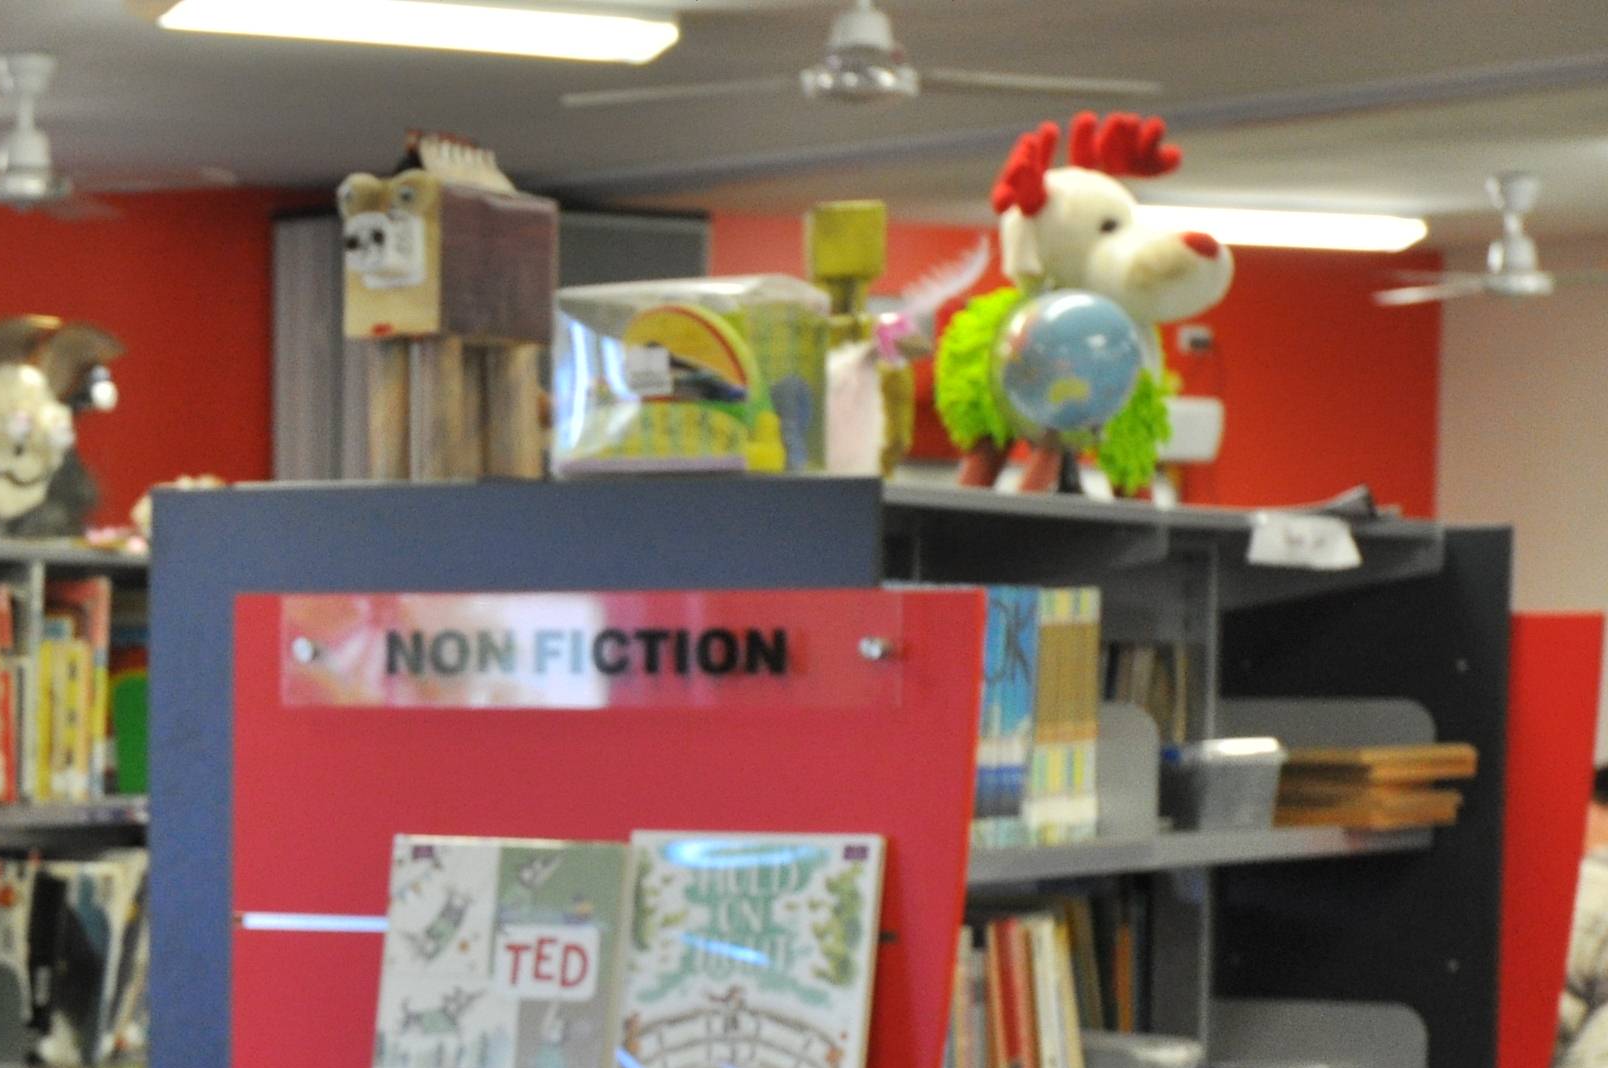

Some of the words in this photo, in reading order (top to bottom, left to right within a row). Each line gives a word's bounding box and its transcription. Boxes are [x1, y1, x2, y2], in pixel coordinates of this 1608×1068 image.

[384, 629, 515, 676] NON
[534, 627, 789, 677] FICTION
[504, 937, 589, 988] TED
